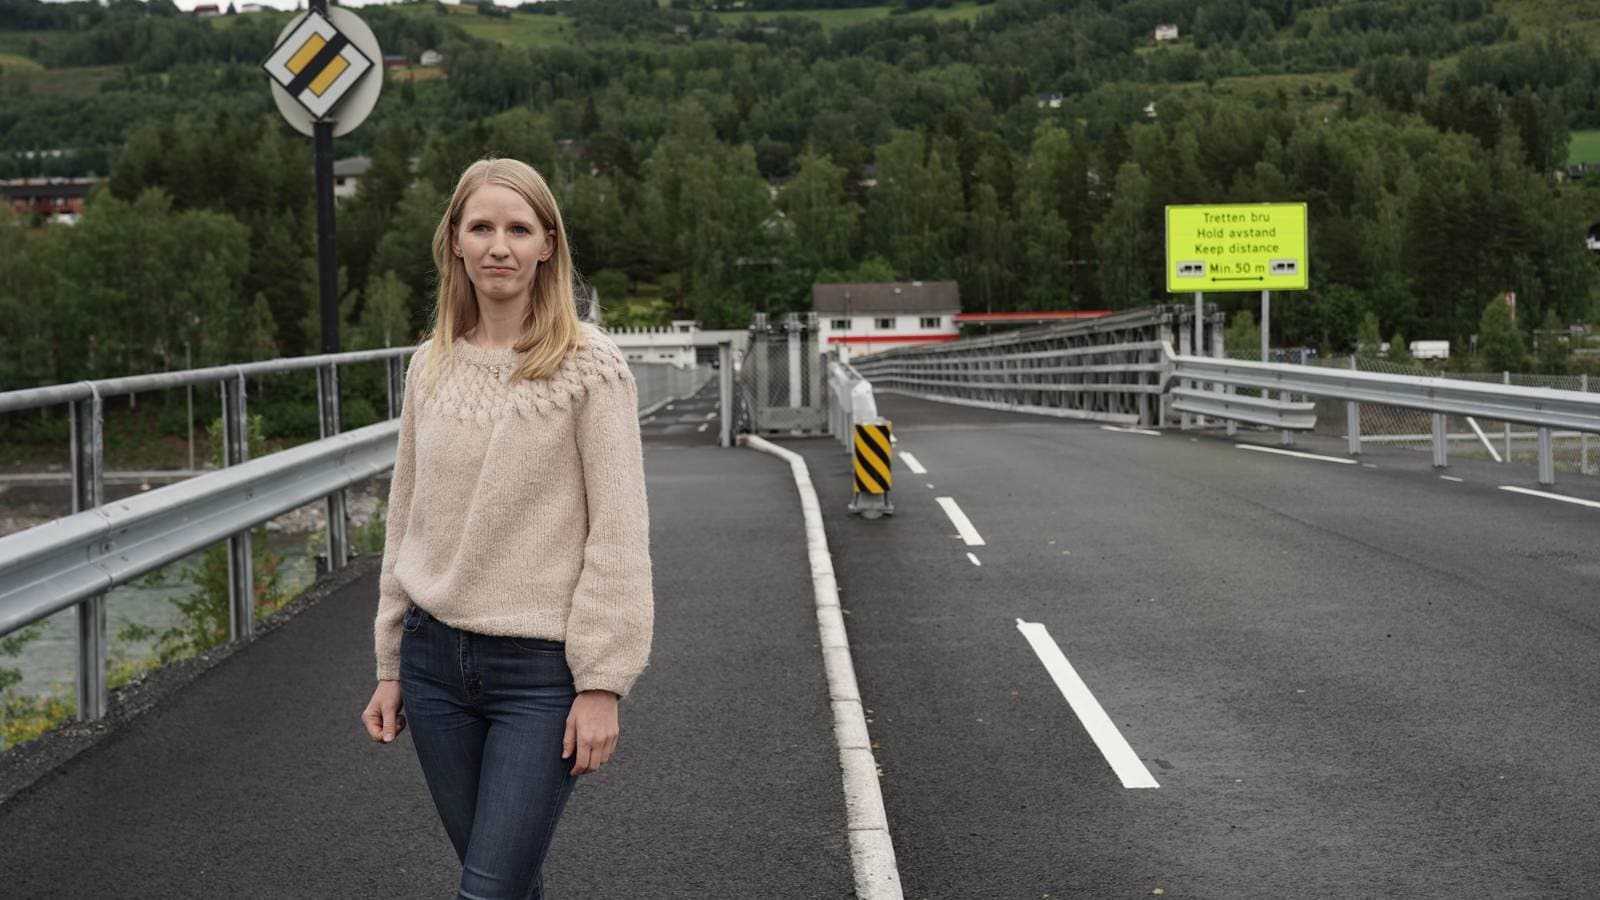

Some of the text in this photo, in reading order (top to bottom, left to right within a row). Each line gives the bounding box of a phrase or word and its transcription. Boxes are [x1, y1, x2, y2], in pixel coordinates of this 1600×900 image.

[1204, 212, 1270, 223] Tretten bru
[1197, 227, 1276, 238] Hold avstand
[1195, 243, 1279, 255] Keep distance
[1255, 264, 1265, 272] m
